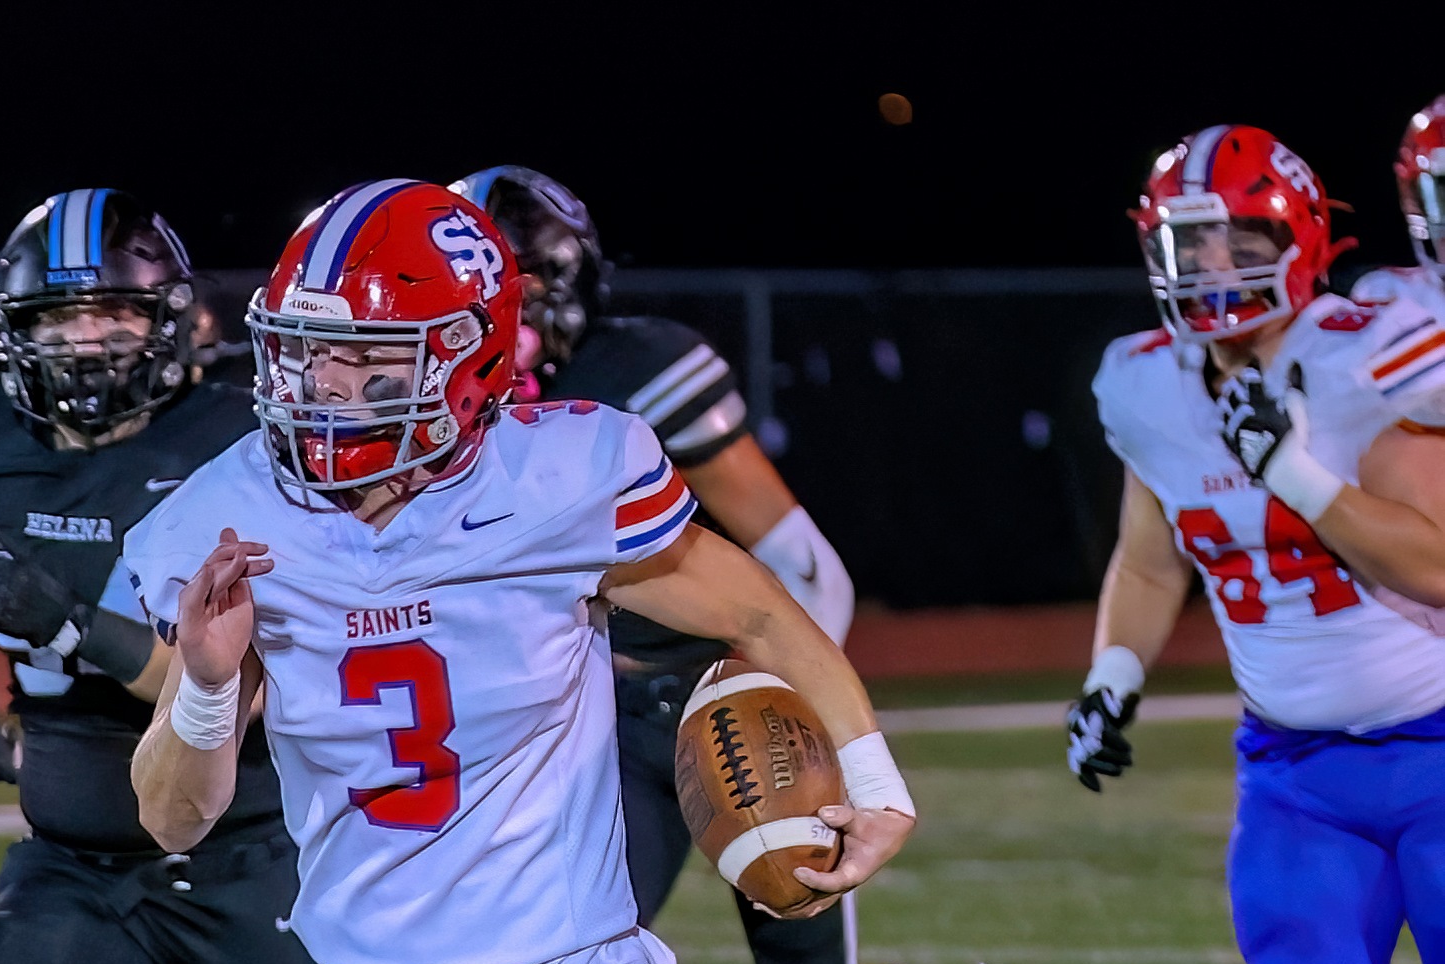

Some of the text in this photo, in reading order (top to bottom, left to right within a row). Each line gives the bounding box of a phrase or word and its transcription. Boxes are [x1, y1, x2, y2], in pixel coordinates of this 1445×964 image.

[23, 511, 114, 543] HELENA
[346, 599, 432, 639] SAINTS
[337, 637, 462, 833] 3
